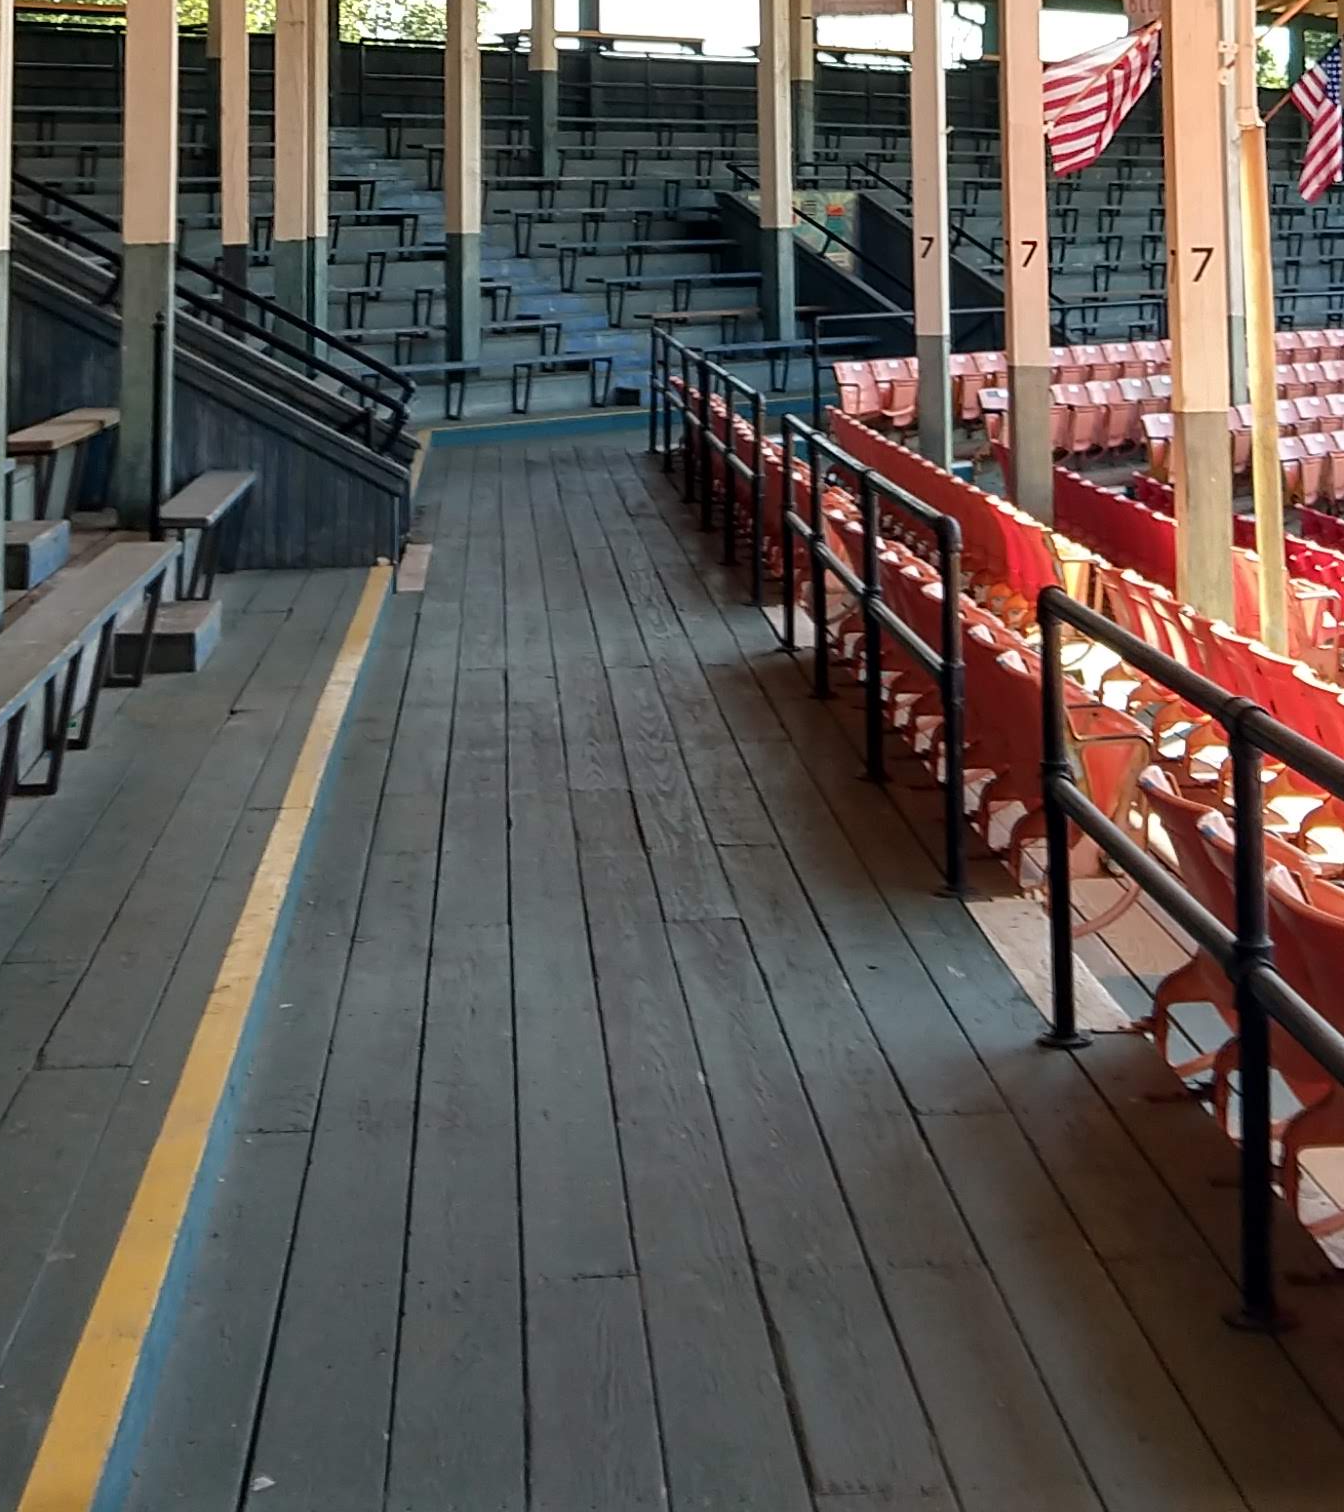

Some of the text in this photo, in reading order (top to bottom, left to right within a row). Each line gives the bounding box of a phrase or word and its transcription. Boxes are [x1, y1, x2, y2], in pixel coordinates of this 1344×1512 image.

[920, 236, 934, 258] 7
[1021, 240, 1038, 267] 7
[1190, 247, 1214, 283] 7
